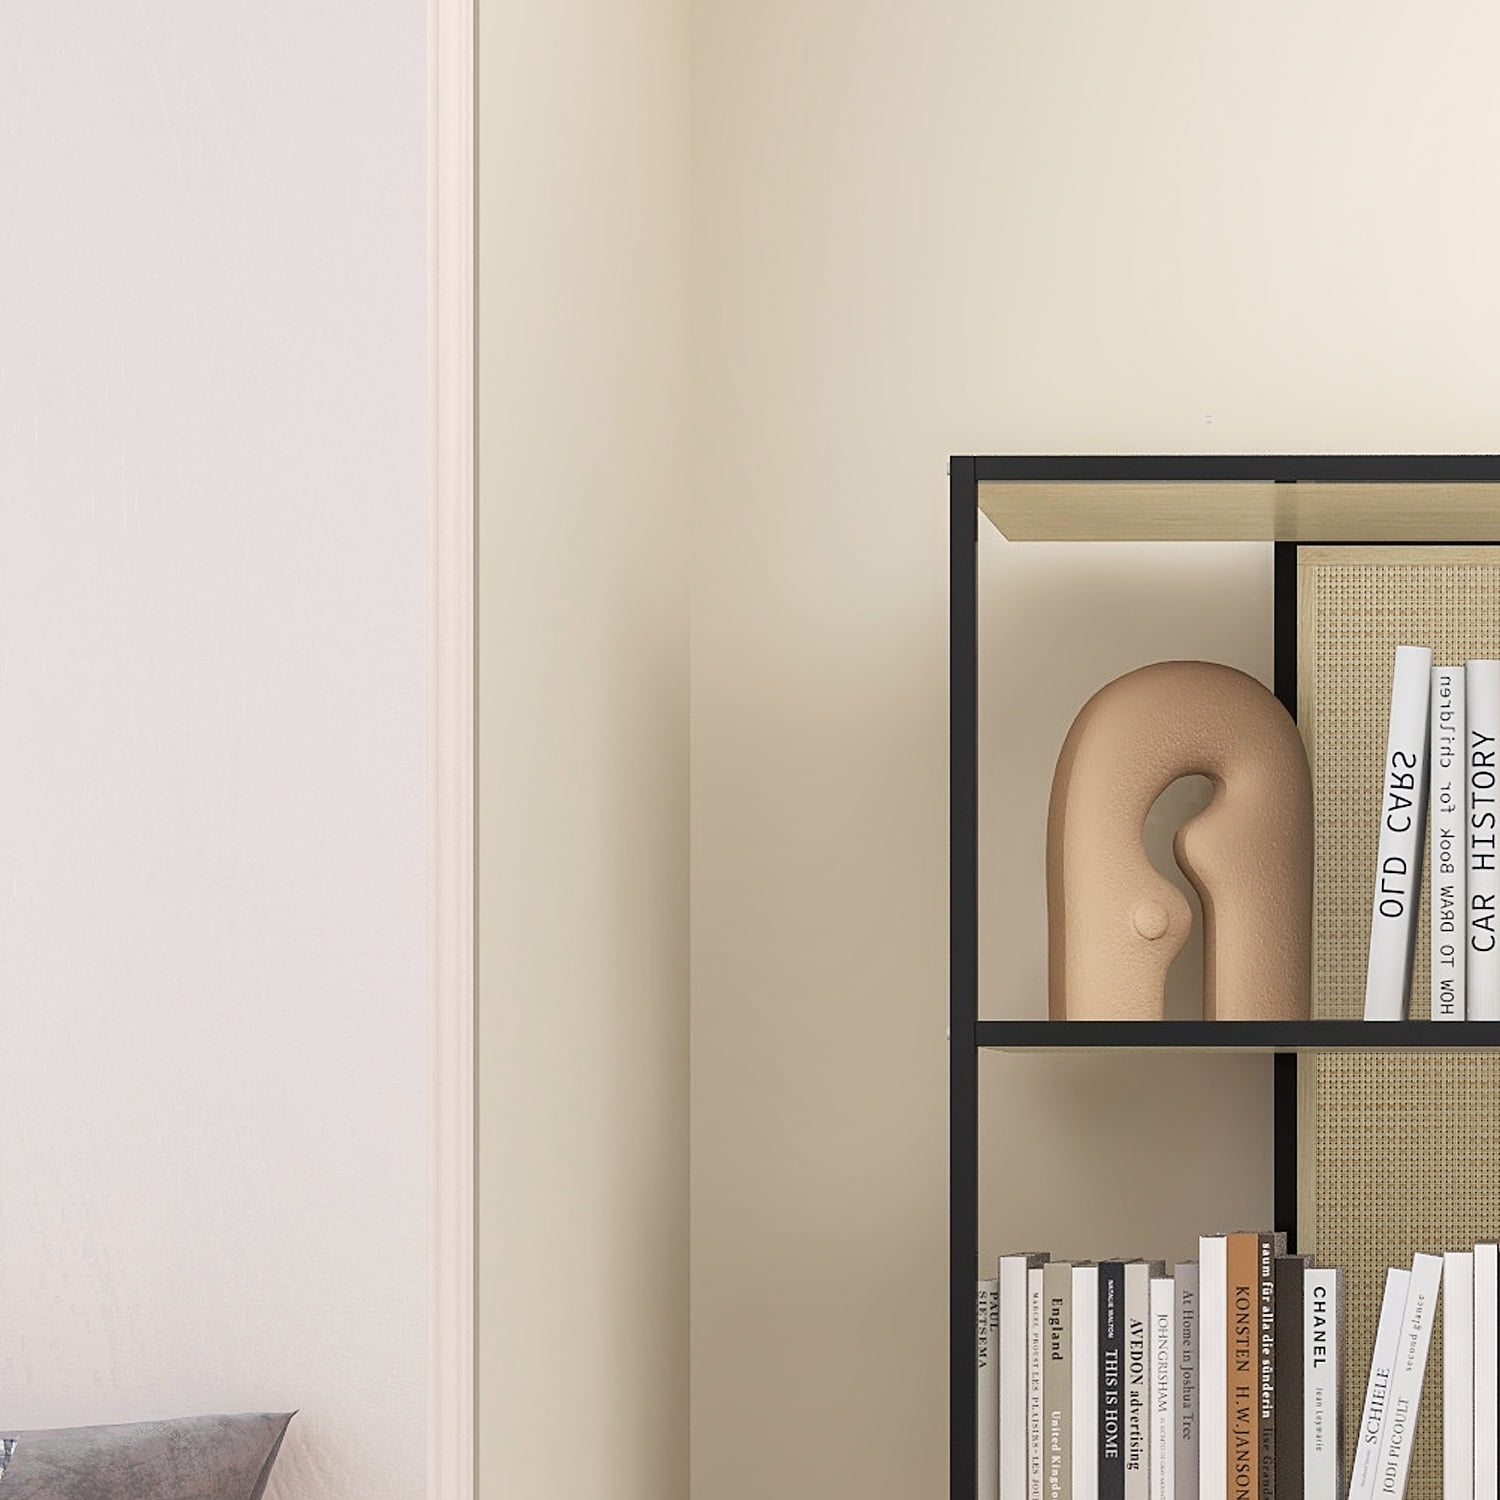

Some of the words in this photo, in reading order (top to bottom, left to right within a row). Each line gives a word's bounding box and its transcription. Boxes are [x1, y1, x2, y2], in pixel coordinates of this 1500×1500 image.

[1471, 730, 1496, 870] HISTORY
[1471, 895, 1496, 952] CAR
[990, 1291, 1000, 1332] PAUL
[1182, 1290, 1194, 1304] At
[1049, 1298, 1064, 1361] England
[1182, 1310, 1194, 1346] Home
[1235, 1286, 1250, 1372] KONSTEN
[1262, 1334, 1274, 1356] die
[1313, 1286, 1326, 1368] CHANEL
[1405, 1334, 1417, 1372] second
[1411, 1294, 1425, 1331] glance
[1105, 1349, 1118, 1386] THIS
[1130, 1318, 1144, 1385] AVEDON
[1182, 1350, 1194, 1363] in
[1105, 1390, 1118, 1405] IS
[1180, 1365, 1195, 1409] Joshua
[1315, 1387, 1324, 1408] Jean
[1365, 1367, 1390, 1445] SCHIELE
[1051, 1411, 1062, 1451] United
[1105, 1410, 1118, 1459] HOME
[1126, 1390, 1144, 1470] advertising
[1182, 1413, 1194, 1441] Tree
[1389, 1397, 1409, 1459] PICOULT
[1383, 1460, 1398, 1494] JODI
